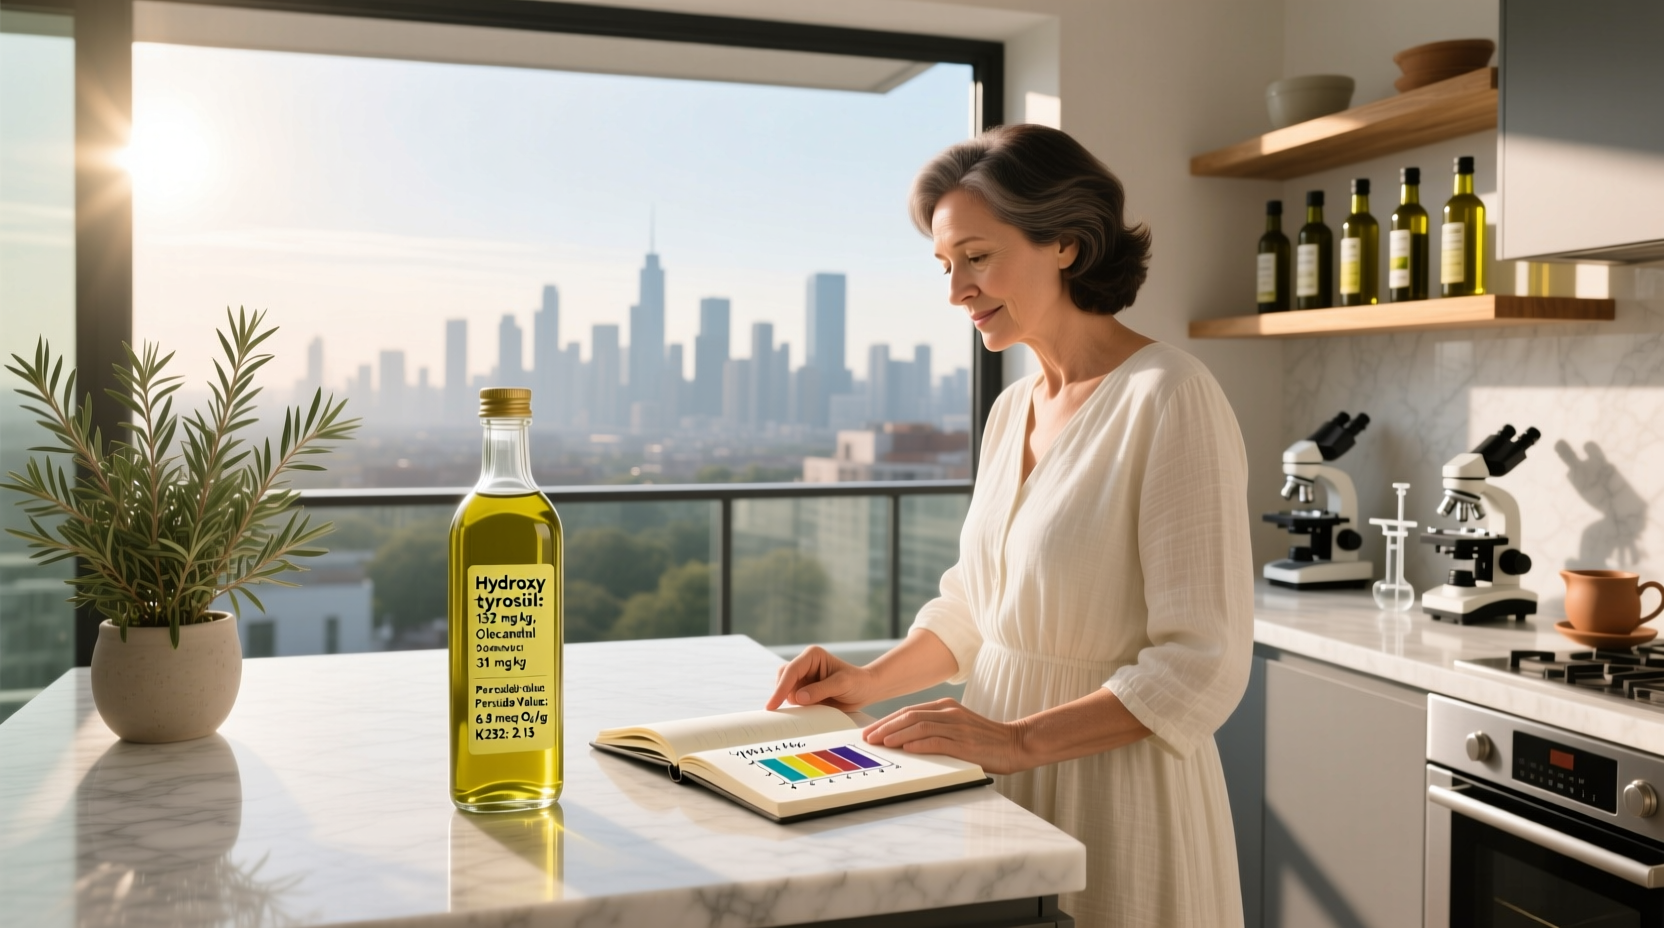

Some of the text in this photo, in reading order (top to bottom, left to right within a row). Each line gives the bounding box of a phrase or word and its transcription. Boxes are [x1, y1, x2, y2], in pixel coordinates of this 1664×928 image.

[475, 574, 547, 595] Hydroxy
[476, 657, 490, 669] 31
[495, 659, 512, 672] mg
